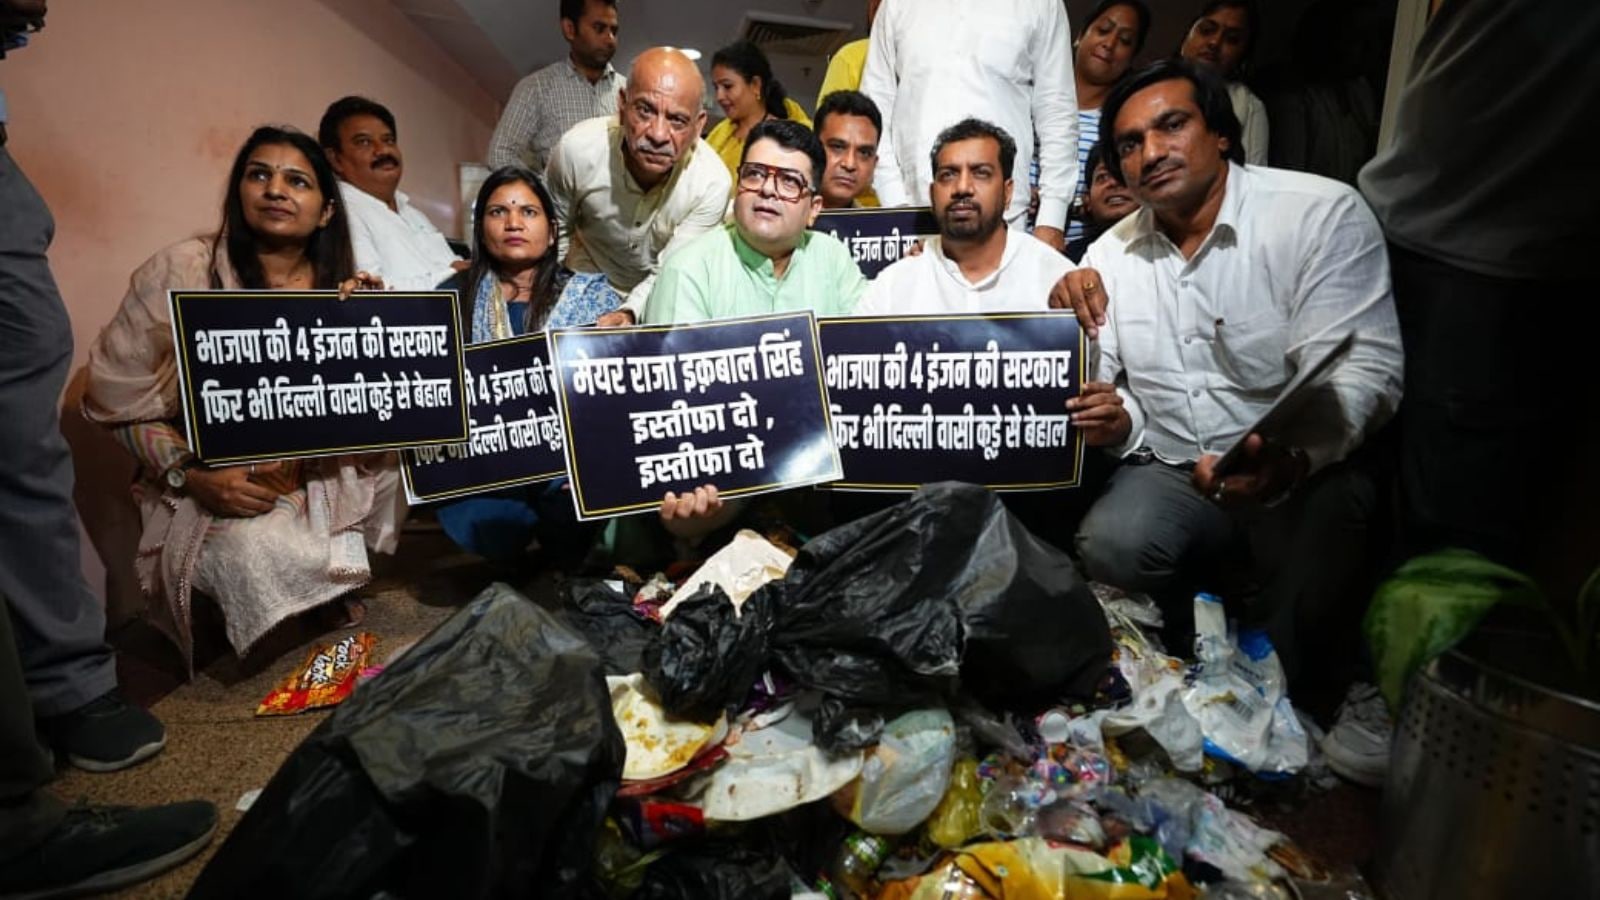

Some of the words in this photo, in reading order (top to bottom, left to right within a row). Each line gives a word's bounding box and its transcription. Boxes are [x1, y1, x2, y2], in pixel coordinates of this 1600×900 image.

[882, 227, 901, 261] की
[195, 329, 262, 364] भाजपा
[262, 317, 291, 362] की
[296, 326, 310, 361] 4
[310, 318, 358, 364] इंजन
[359, 315, 385, 358] की
[386, 325, 448, 358] सरकार
[566, 347, 627, 396] मेयर
[626, 354, 678, 393] राजा
[678, 345, 758, 394] इक़बाल
[758, 327, 804, 379] सिंह
[479, 373, 491, 404] 4
[489, 364, 529, 406] इंजन
[526, 356, 549, 396] की
[826, 353, 881, 390] भाजपा
[882, 341, 908, 390] की
[910, 351, 924, 390] 4
[925, 341, 972, 394] इंजन
[973, 339, 1002, 389] की
[1001, 349, 1072, 389] सरकार
[201, 378, 245, 424] फिर
[247, 376, 275, 420] भी
[273, 374, 327, 419] दिल्ली
[327, 372, 368, 415] वासी
[393, 371, 411, 409] से
[411, 370, 453, 408] बेहाल
[628, 399, 726, 445] इस्तीफा
[728, 391, 760, 429] दो
[469, 413, 508, 457] दिल्ली
[506, 408, 542, 450] वासी
[862, 403, 886, 450] भी
[885, 403, 934, 450] दिल्ली
[935, 403, 974, 450] वासी
[1004, 402, 1022, 449] से
[1022, 402, 1069, 448] बेहाल
[634, 441, 732, 488] इस्तीफा
[734, 434, 764, 470] दो
